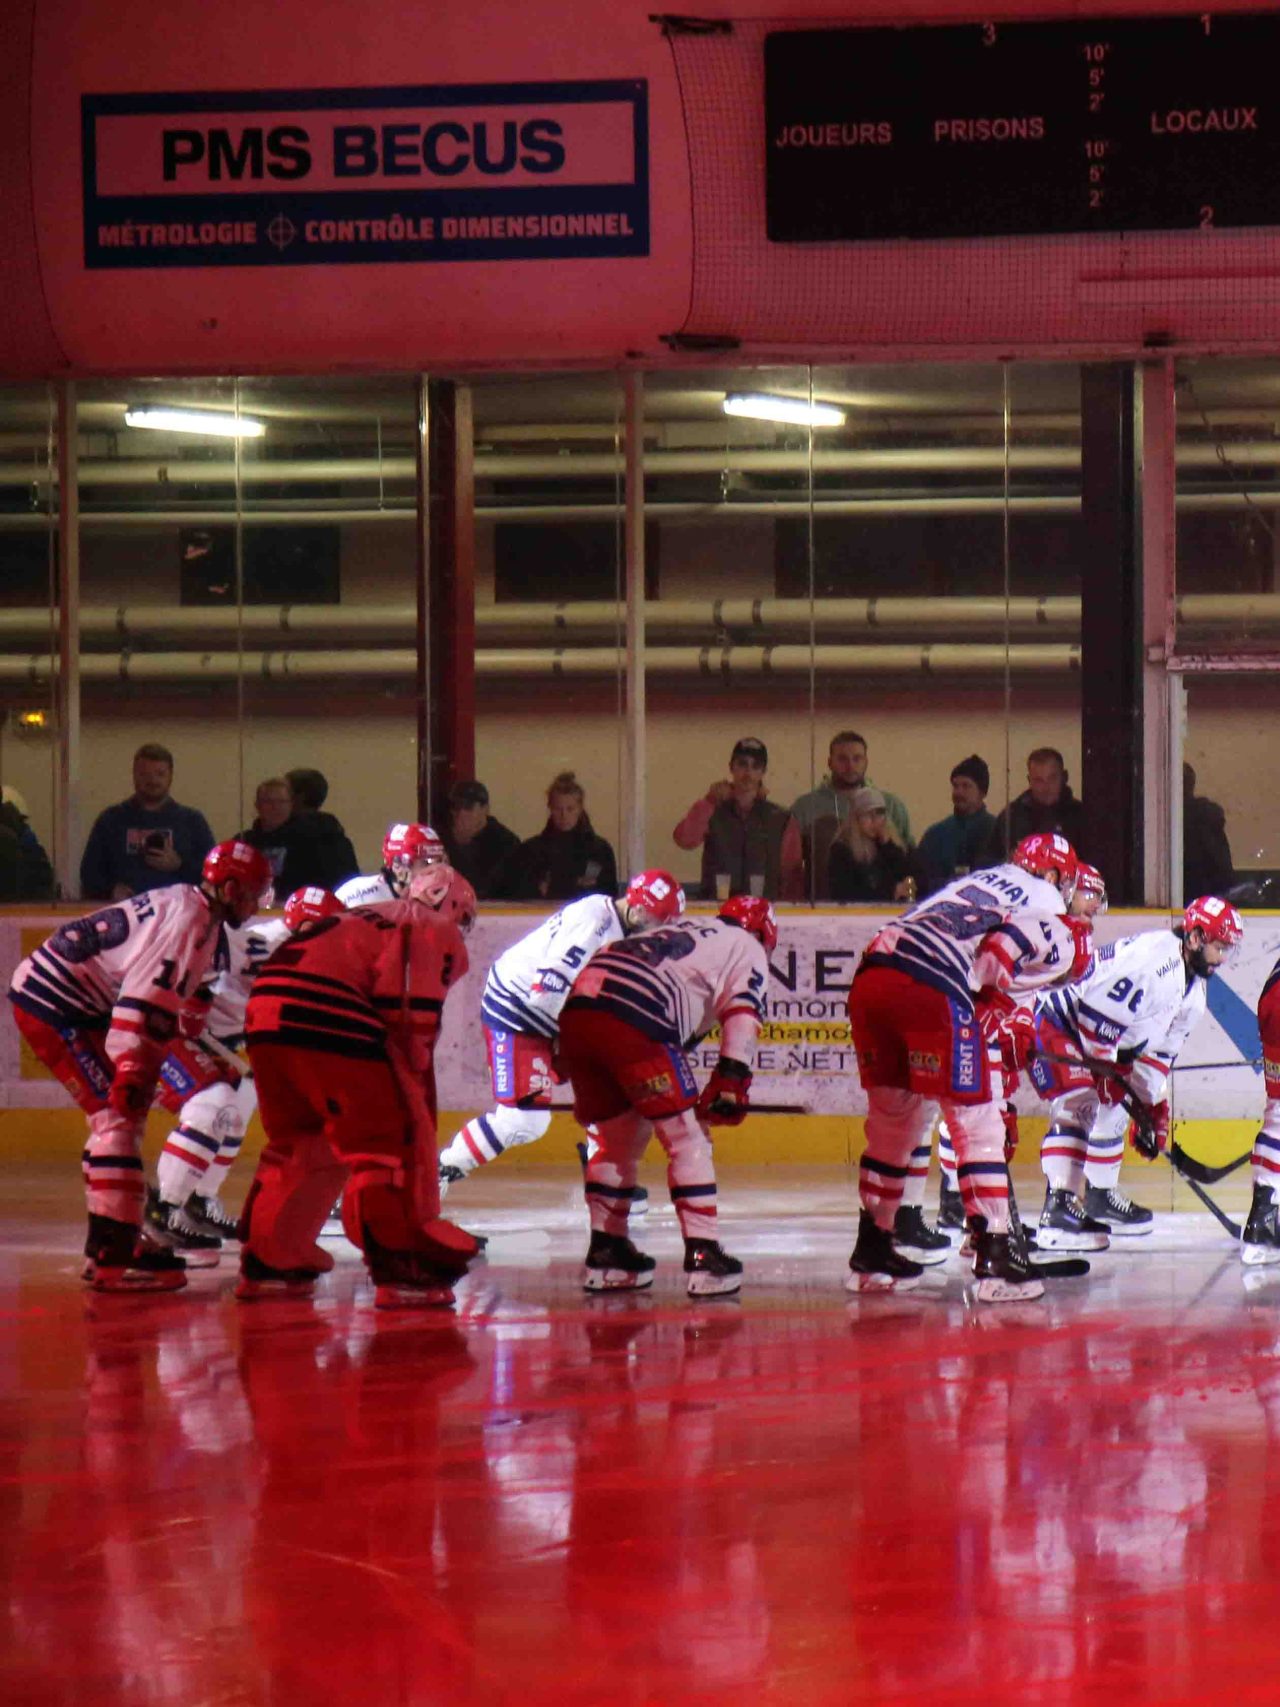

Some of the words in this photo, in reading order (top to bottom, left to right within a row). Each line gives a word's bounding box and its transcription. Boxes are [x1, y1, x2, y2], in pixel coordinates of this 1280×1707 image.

[983, 23, 997, 46] 3
[1200, 14, 1212, 36] 1
[934, 116, 1045, 142] PRISONS
[1151, 107, 1258, 134] LOCAUX
[775, 122, 892, 147] JOUEURS
[161, 126, 312, 183] PMS
[332, 119, 567, 178] BECUS
[97, 218, 258, 248] MÉTROLOGIE
[304, 213, 434, 244] CONTRÔLE
[441, 212, 634, 241] DIMENSIONNEL
[788, 1050, 858, 1070] NET
[959, 1042, 975, 1087] RENT
